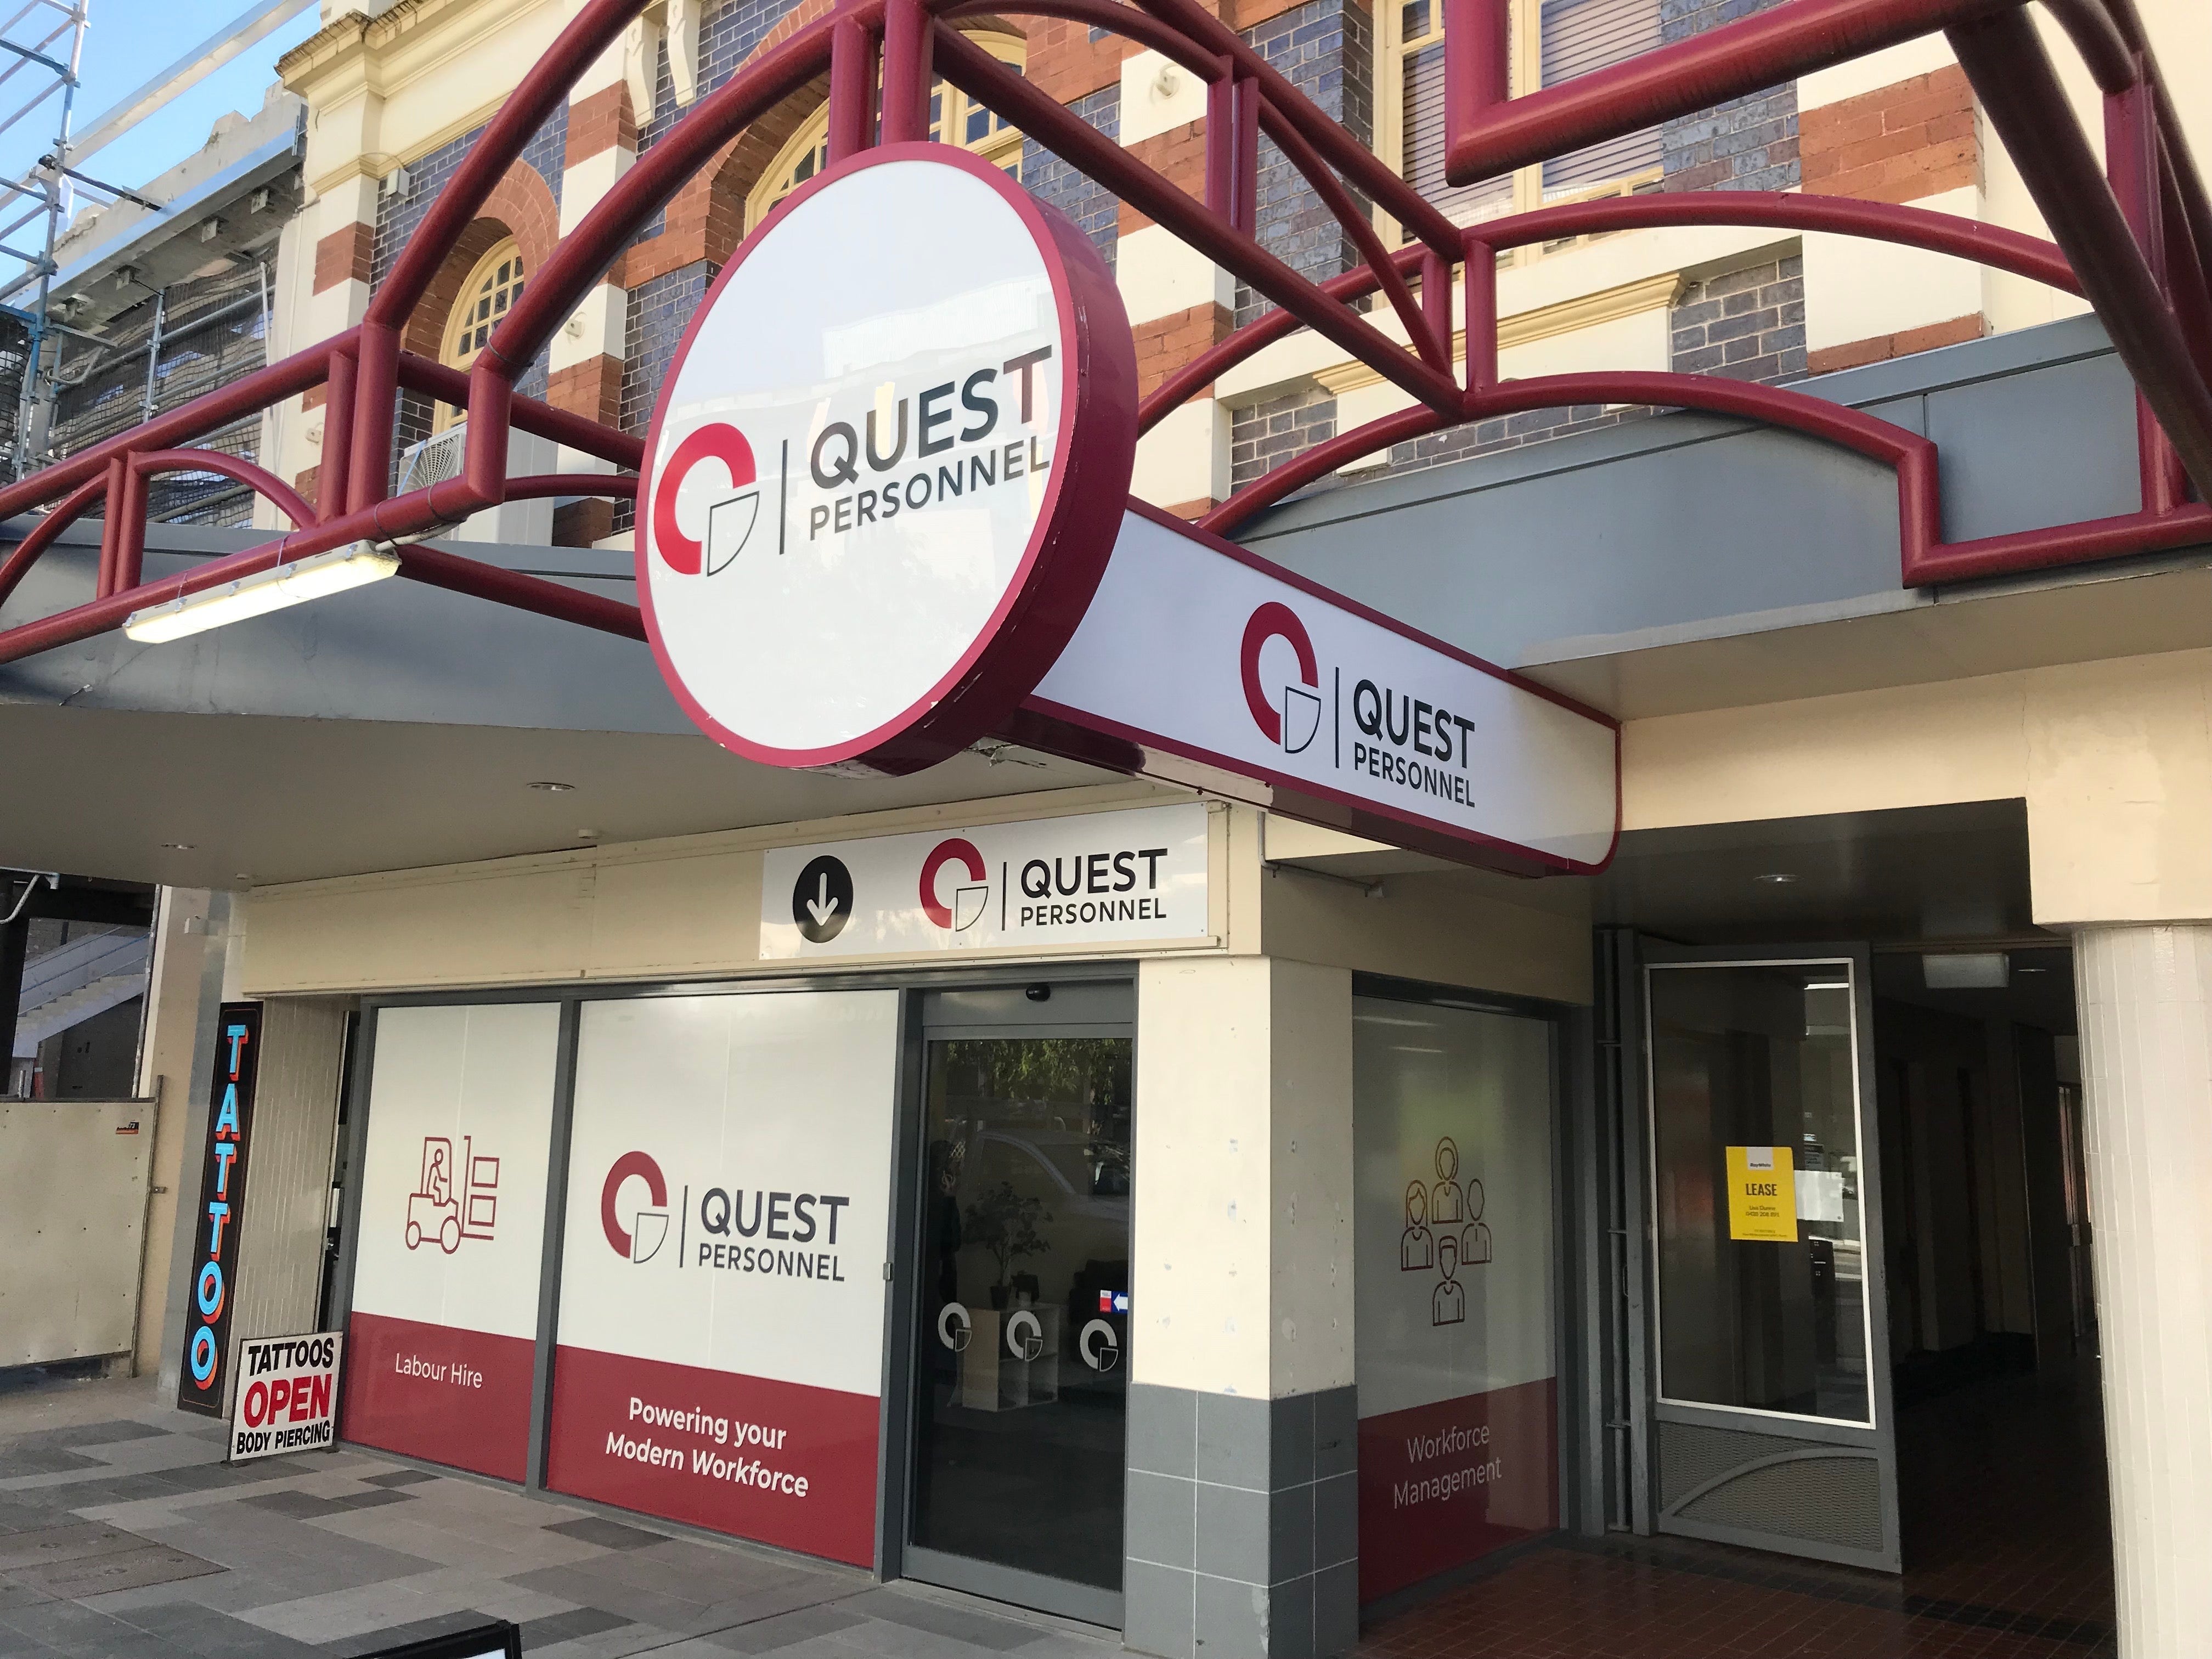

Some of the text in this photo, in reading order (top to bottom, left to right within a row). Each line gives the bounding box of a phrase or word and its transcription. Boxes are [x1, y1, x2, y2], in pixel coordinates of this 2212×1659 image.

[810, 345, 1052, 489] QUEST
[810, 436, 1051, 541] PERSONNEL
[1353, 679, 1475, 769] QUEST
[1355, 742, 1475, 808] PERSONNEL
[1021, 848, 1168, 899] QUEST
[1021, 898, 1167, 927] PERSONNEL
[191, 1024, 249, 1390] TATTOO
[701, 1187, 849, 1244] QUEST
[1746, 1183, 1778, 1196] LEASE
[699, 1243, 845, 1282] PERSONNEL
[249, 1338, 334, 1376] TATTOOS
[396, 1353, 483, 1389] Labour Hire
[244, 1373, 332, 1428] OPEN
[629, 1397, 787, 1450] Powering your
[236, 1420, 330, 1454] BODY PIERCING
[1407, 1426, 1490, 1464] Workforce
[606, 1431, 809, 1497] Modern Workforce
[1395, 1457, 1502, 1509] Management
